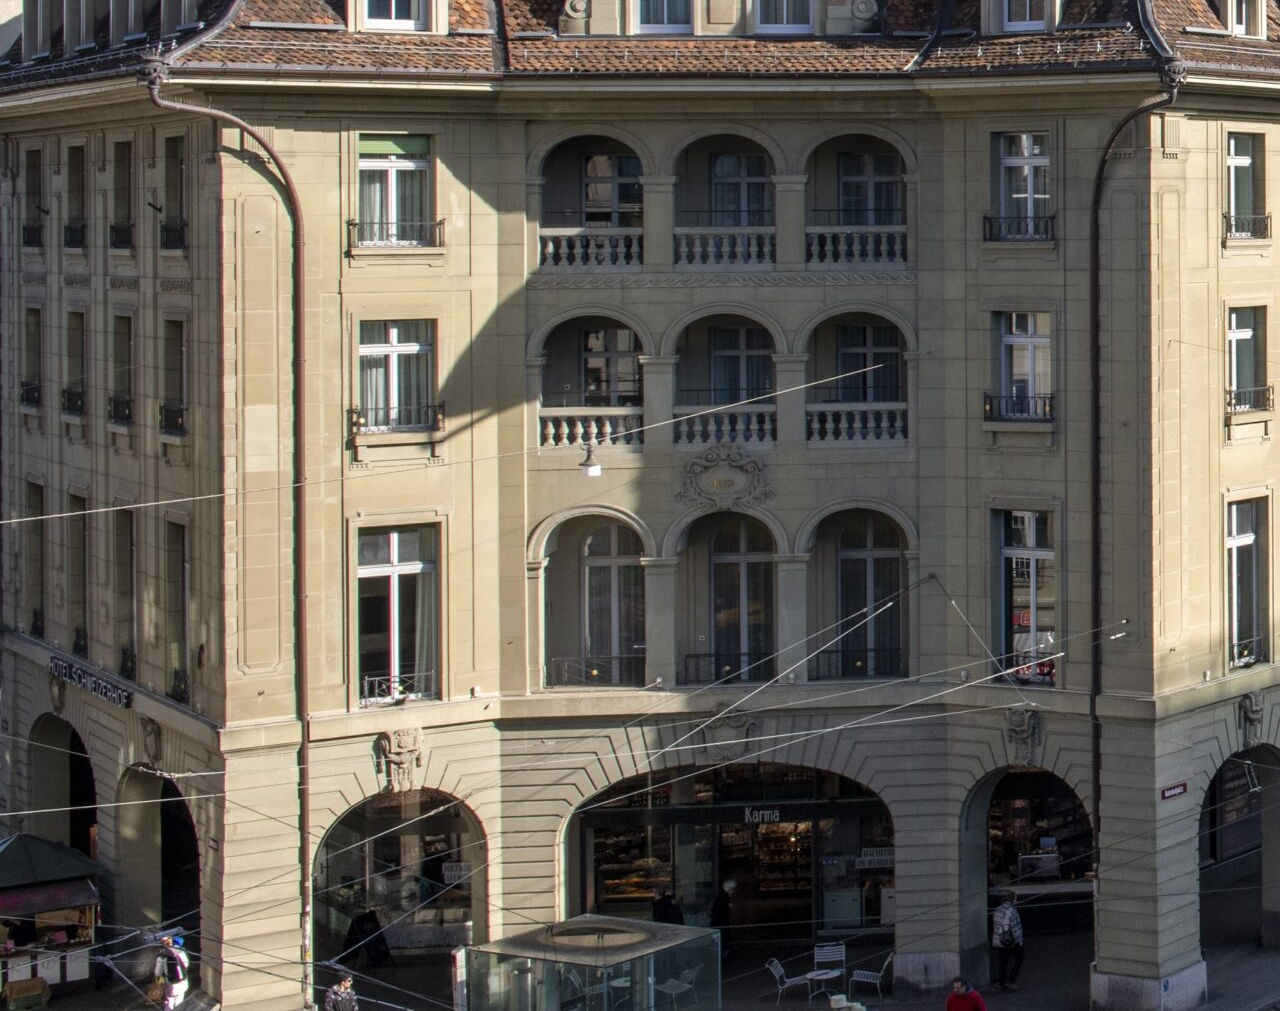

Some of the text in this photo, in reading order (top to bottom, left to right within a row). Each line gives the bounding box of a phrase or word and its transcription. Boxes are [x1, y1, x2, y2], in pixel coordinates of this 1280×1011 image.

[49, 657, 128, 709] HOTEL SCHWEIZERHOF
[744, 806, 780, 823] Karma
